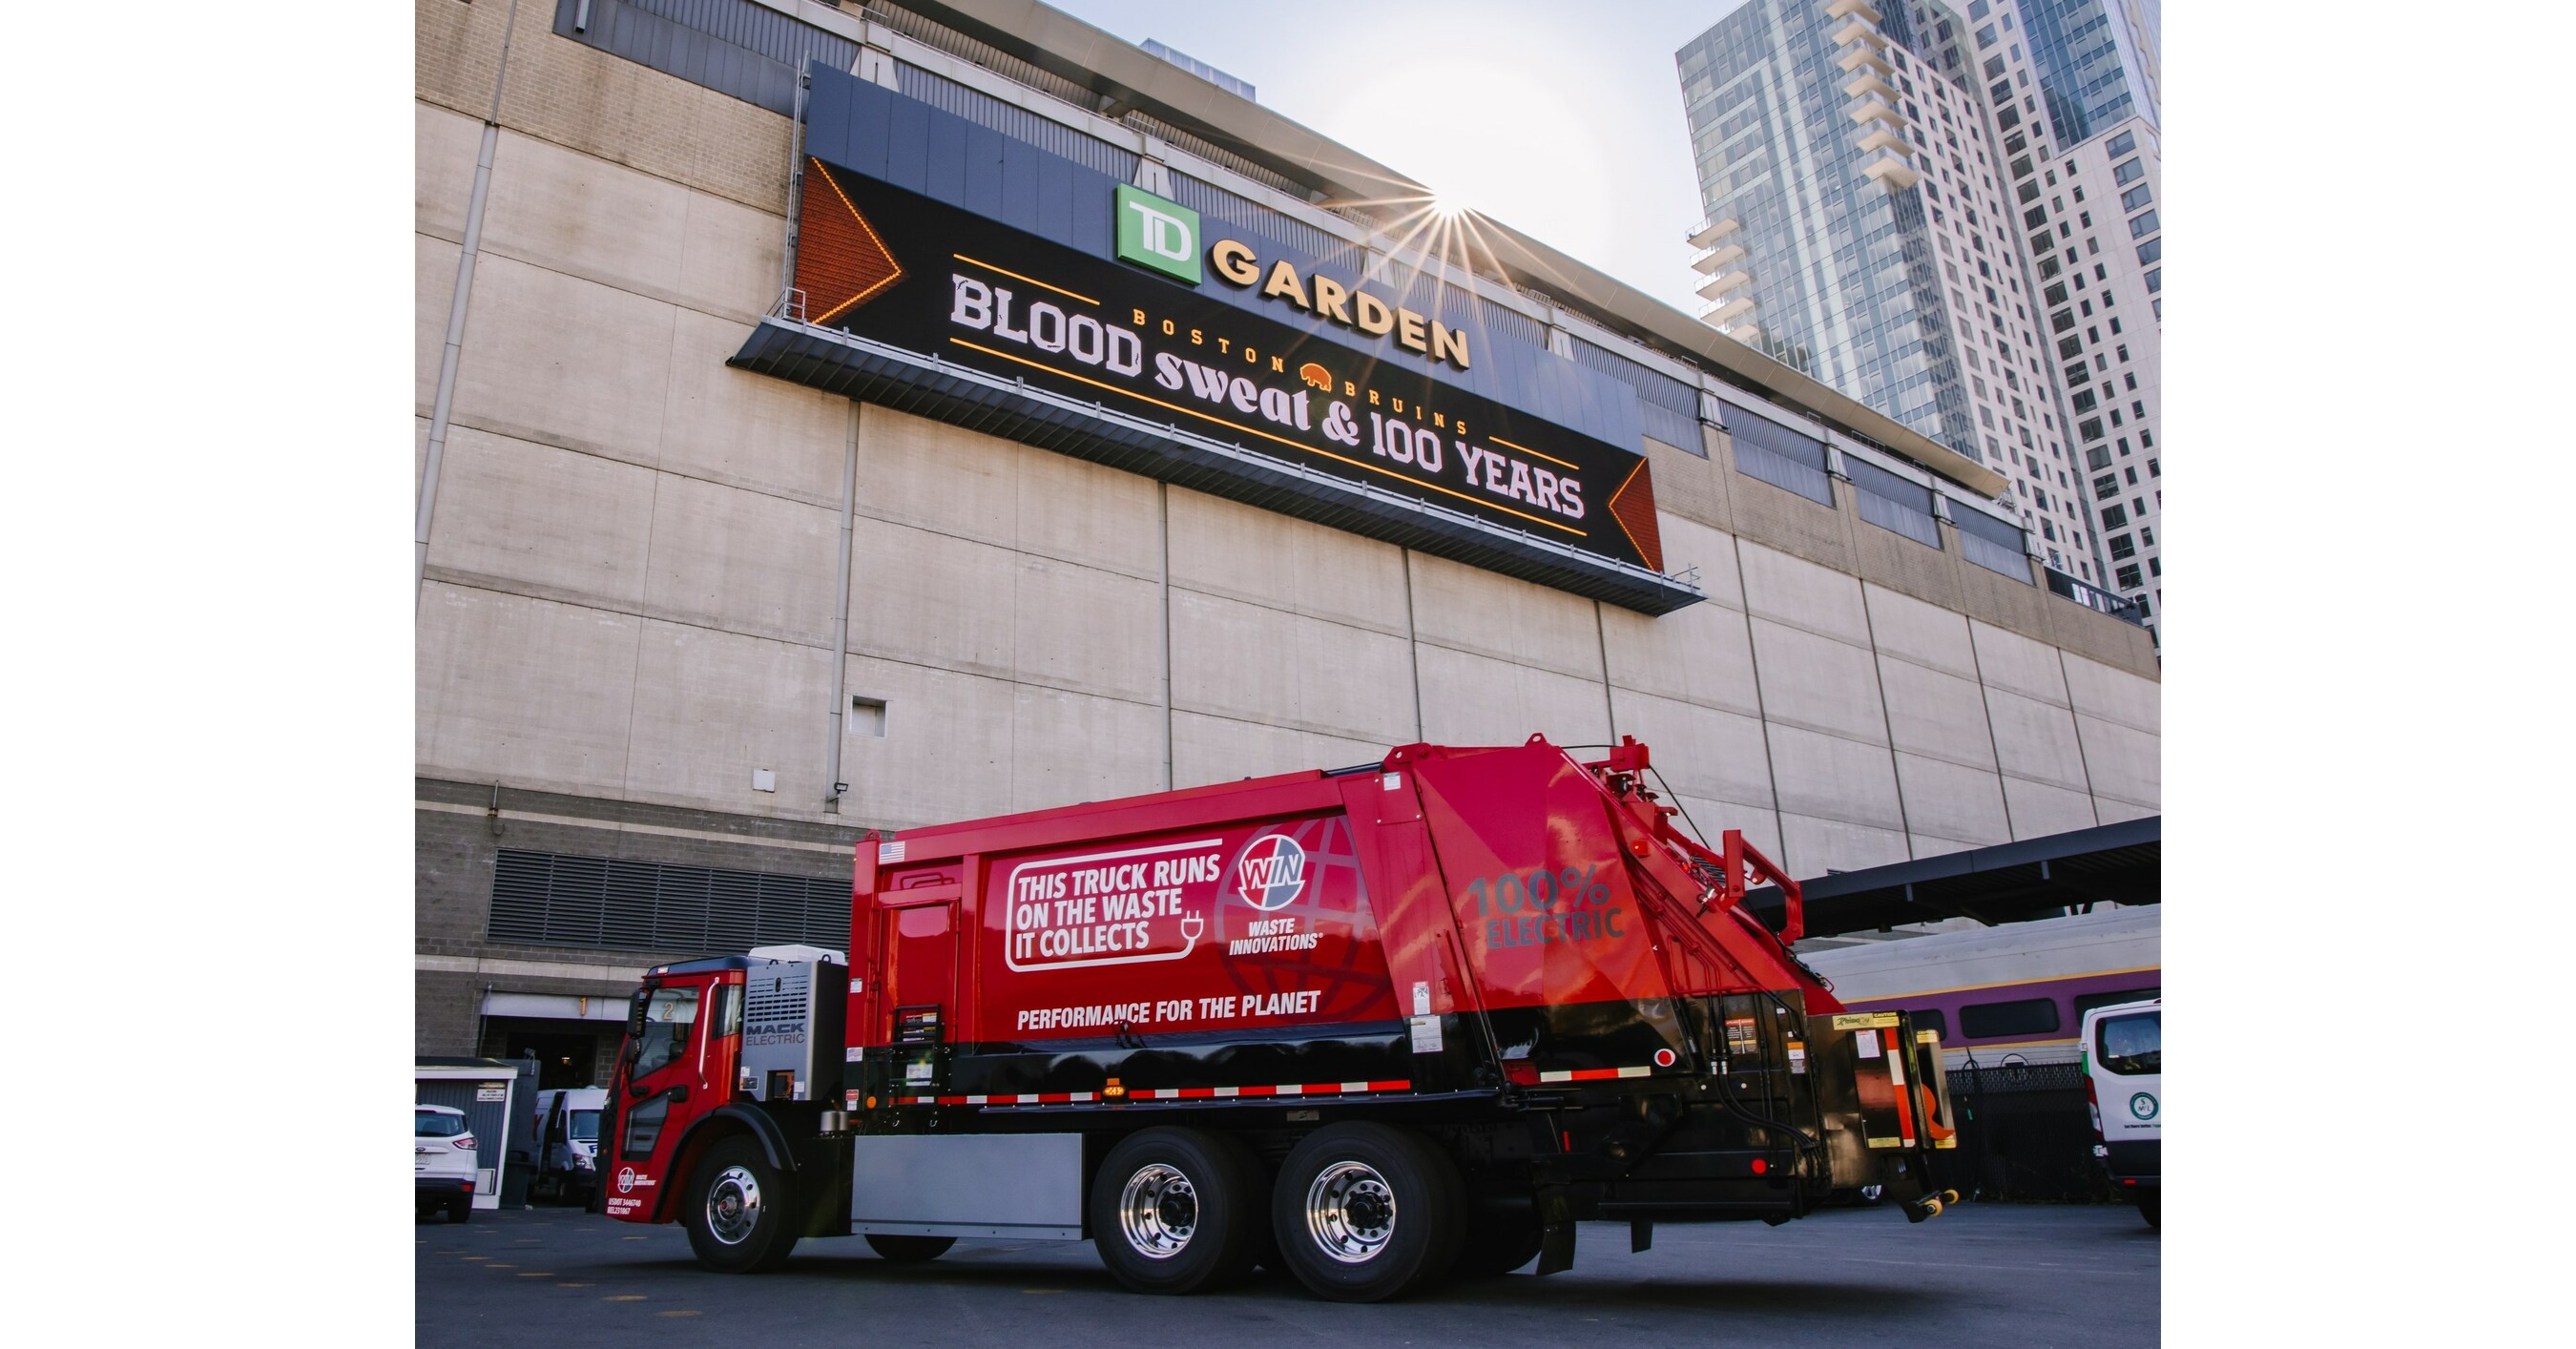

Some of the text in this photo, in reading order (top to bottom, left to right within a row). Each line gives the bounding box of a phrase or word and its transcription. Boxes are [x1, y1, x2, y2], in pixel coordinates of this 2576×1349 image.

[1129, 200, 1470, 369] TD GARDEN
[1132, 307, 1466, 435] BOSTON BRUINS
[950, 273, 1585, 520] BLOOD sweat & 100 YEARS
[1018, 854, 1221, 903] THIS TRUCK RUNS
[1238, 853, 1305, 891] WIN
[1467, 863, 1610, 917] 100%
[1016, 888, 1183, 931] ON THE WASTE
[1249, 917, 1296, 938] WASTE
[1486, 907, 1626, 950] ELECTRIC
[1015, 921, 1150, 960] IT COLLECTS
[580, 996, 587, 1017] 1
[663, 1002, 674, 1020] 2
[1017, 990, 1322, 1030] PERFORMANCE FOR THE PLANET
[746, 1023, 805, 1035] MACK
[746, 1033, 805, 1047] ELECTRIC
